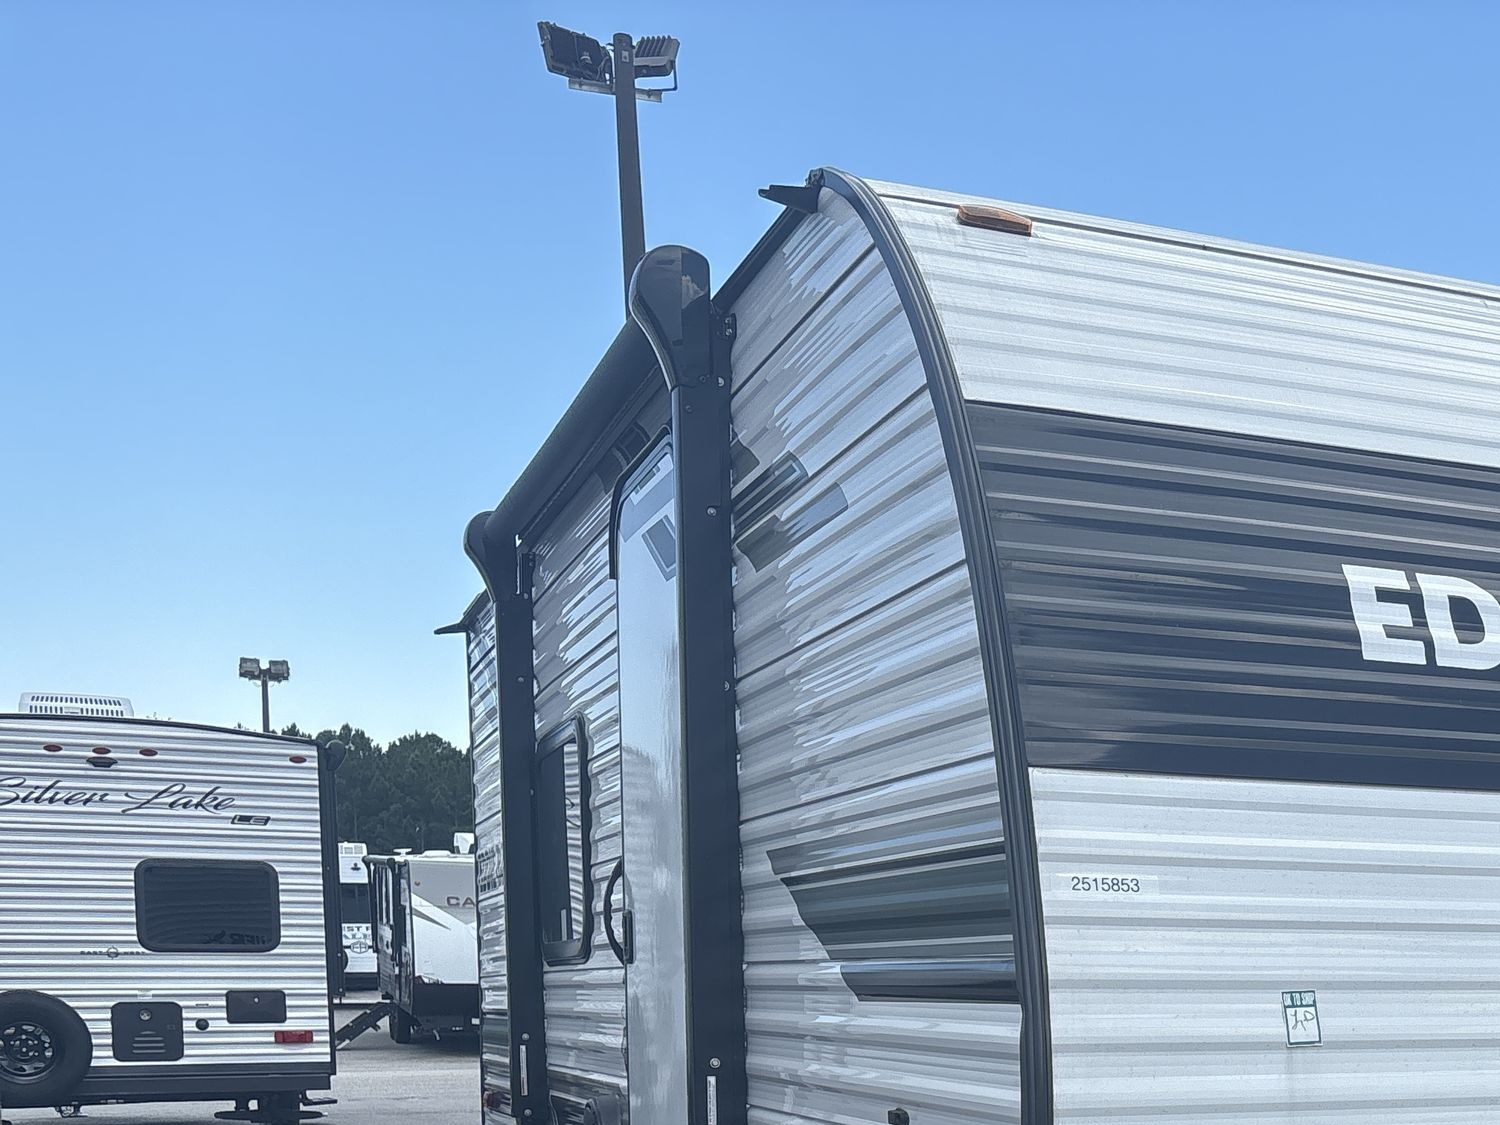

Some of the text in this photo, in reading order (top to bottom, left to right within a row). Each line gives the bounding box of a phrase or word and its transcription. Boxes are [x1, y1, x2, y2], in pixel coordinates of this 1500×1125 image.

[0, 776, 237, 814] Silver Lake
[1070, 876, 1141, 893] 2515853
